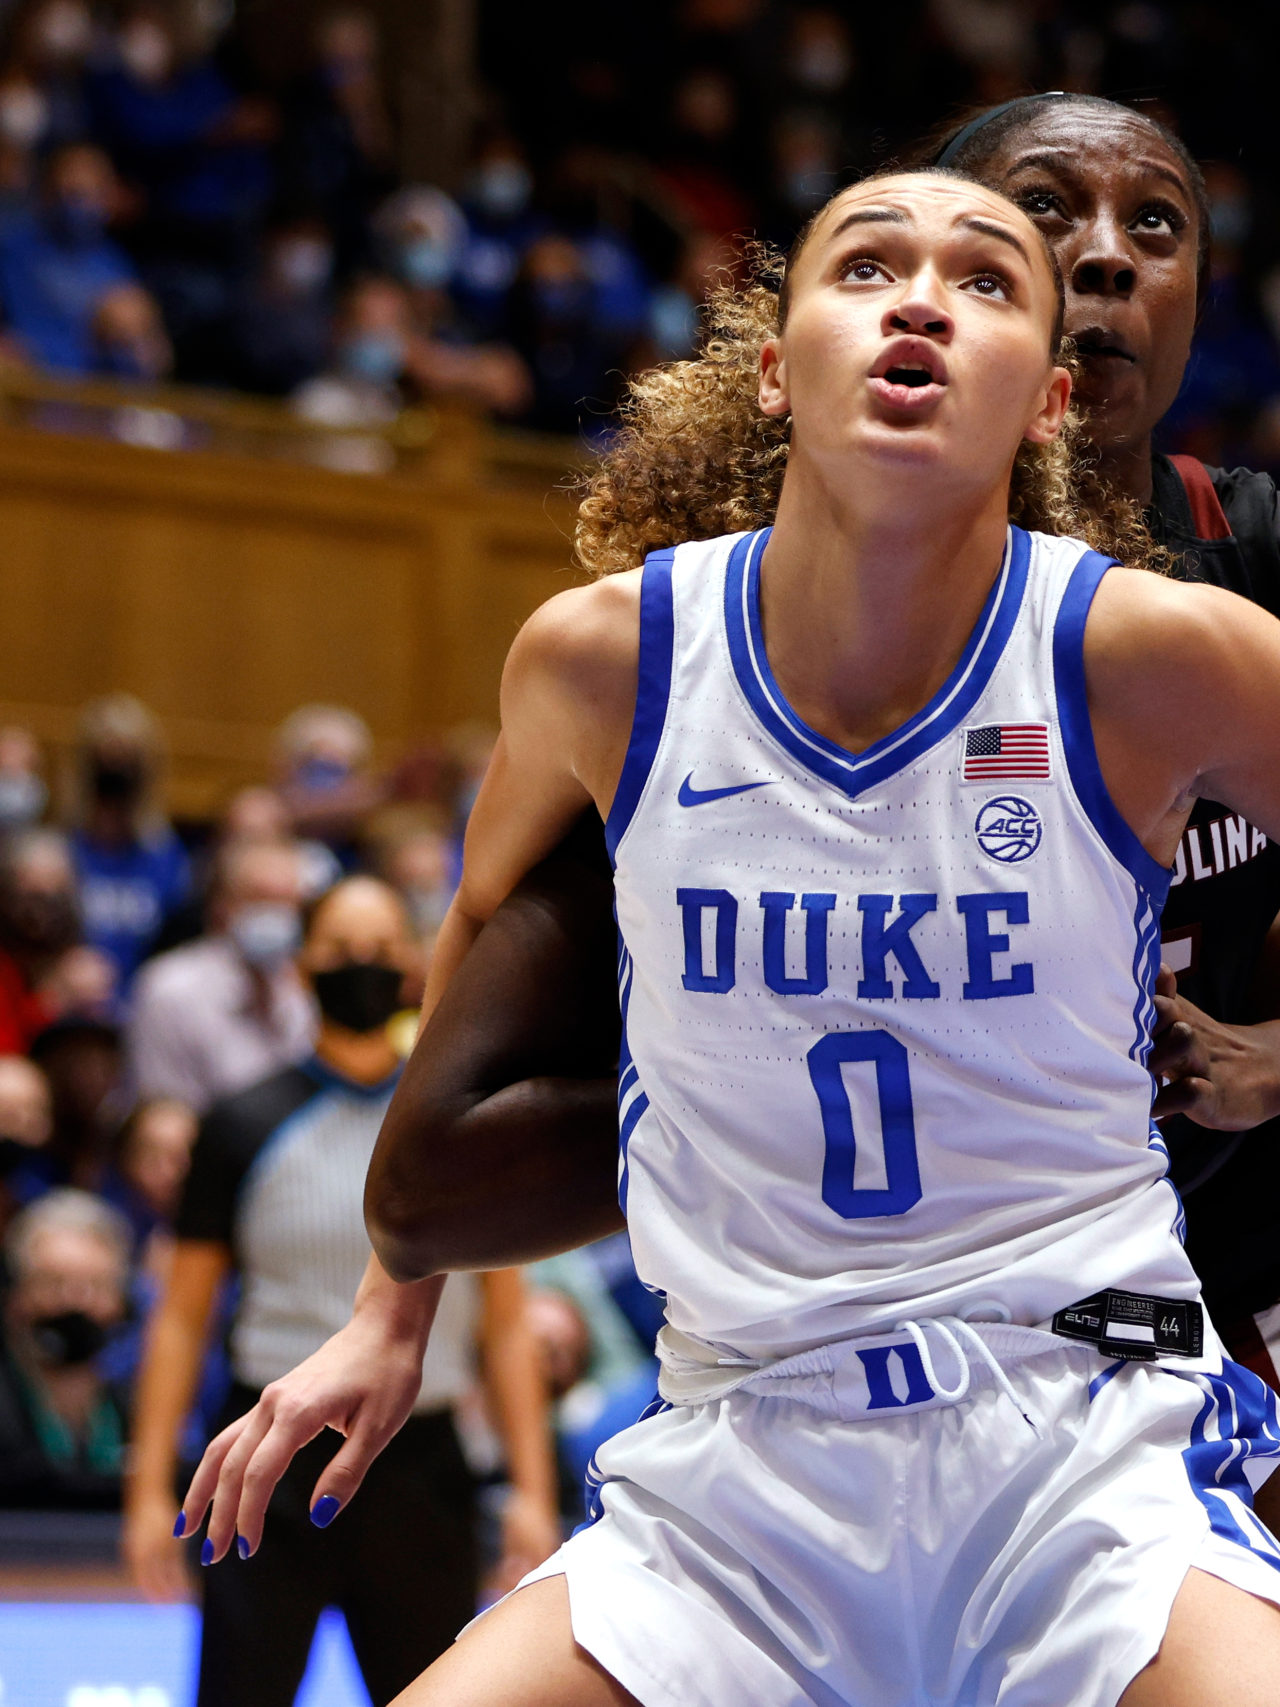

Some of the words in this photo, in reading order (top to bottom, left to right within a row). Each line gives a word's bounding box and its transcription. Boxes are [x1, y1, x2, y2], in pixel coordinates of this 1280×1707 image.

[984, 818, 1040, 833] ACC
[676, 887, 1035, 1000] DUKE
[806, 1028, 923, 1220] 0
[1160, 1316, 1180, 1338] 44
